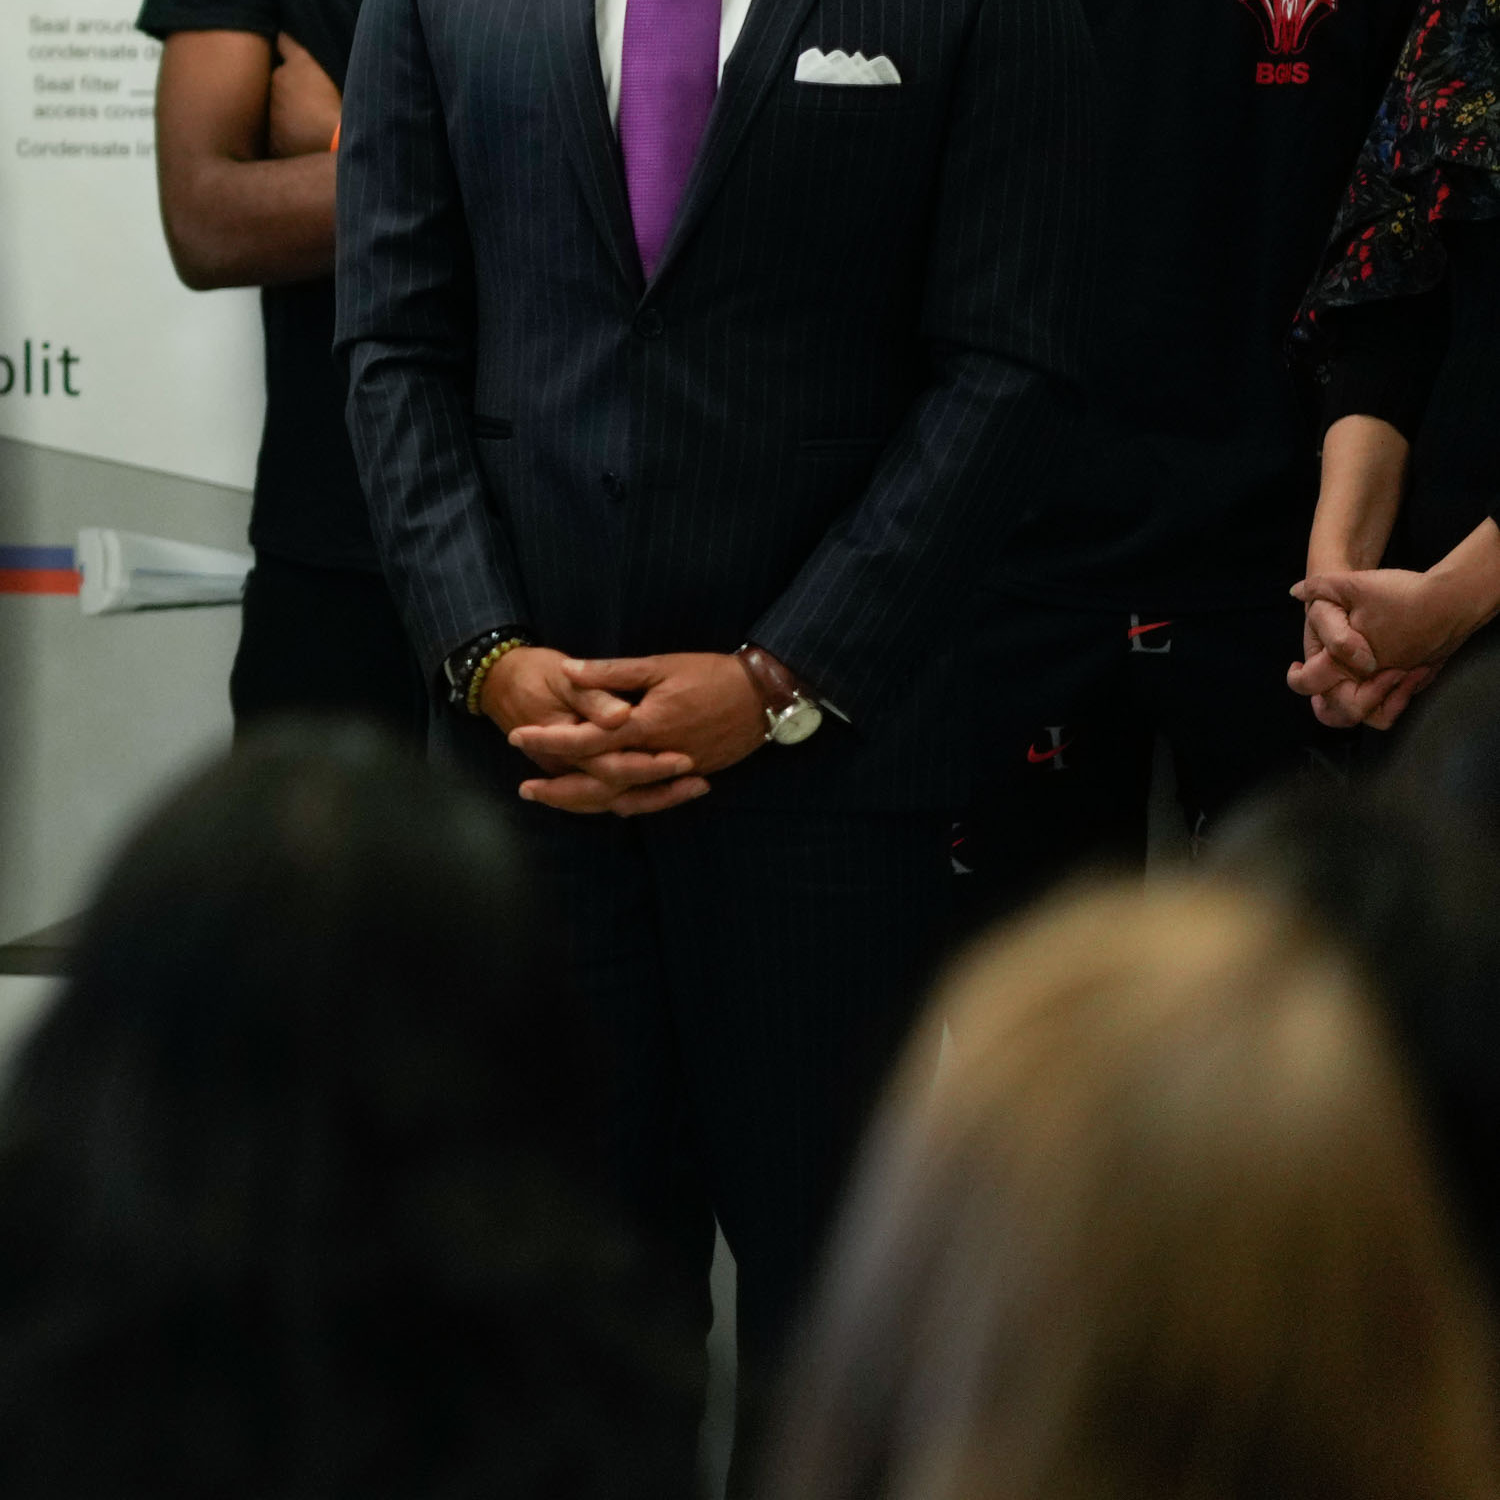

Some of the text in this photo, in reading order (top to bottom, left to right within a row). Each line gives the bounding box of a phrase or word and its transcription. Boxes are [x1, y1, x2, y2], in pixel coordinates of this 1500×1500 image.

[29, 16, 138, 35] Seal aroun
[28, 43, 140, 62] condensate
[34, 74, 75, 94] Seal
[103, 103, 156, 121] cove
[16, 137, 131, 159] Condensate
